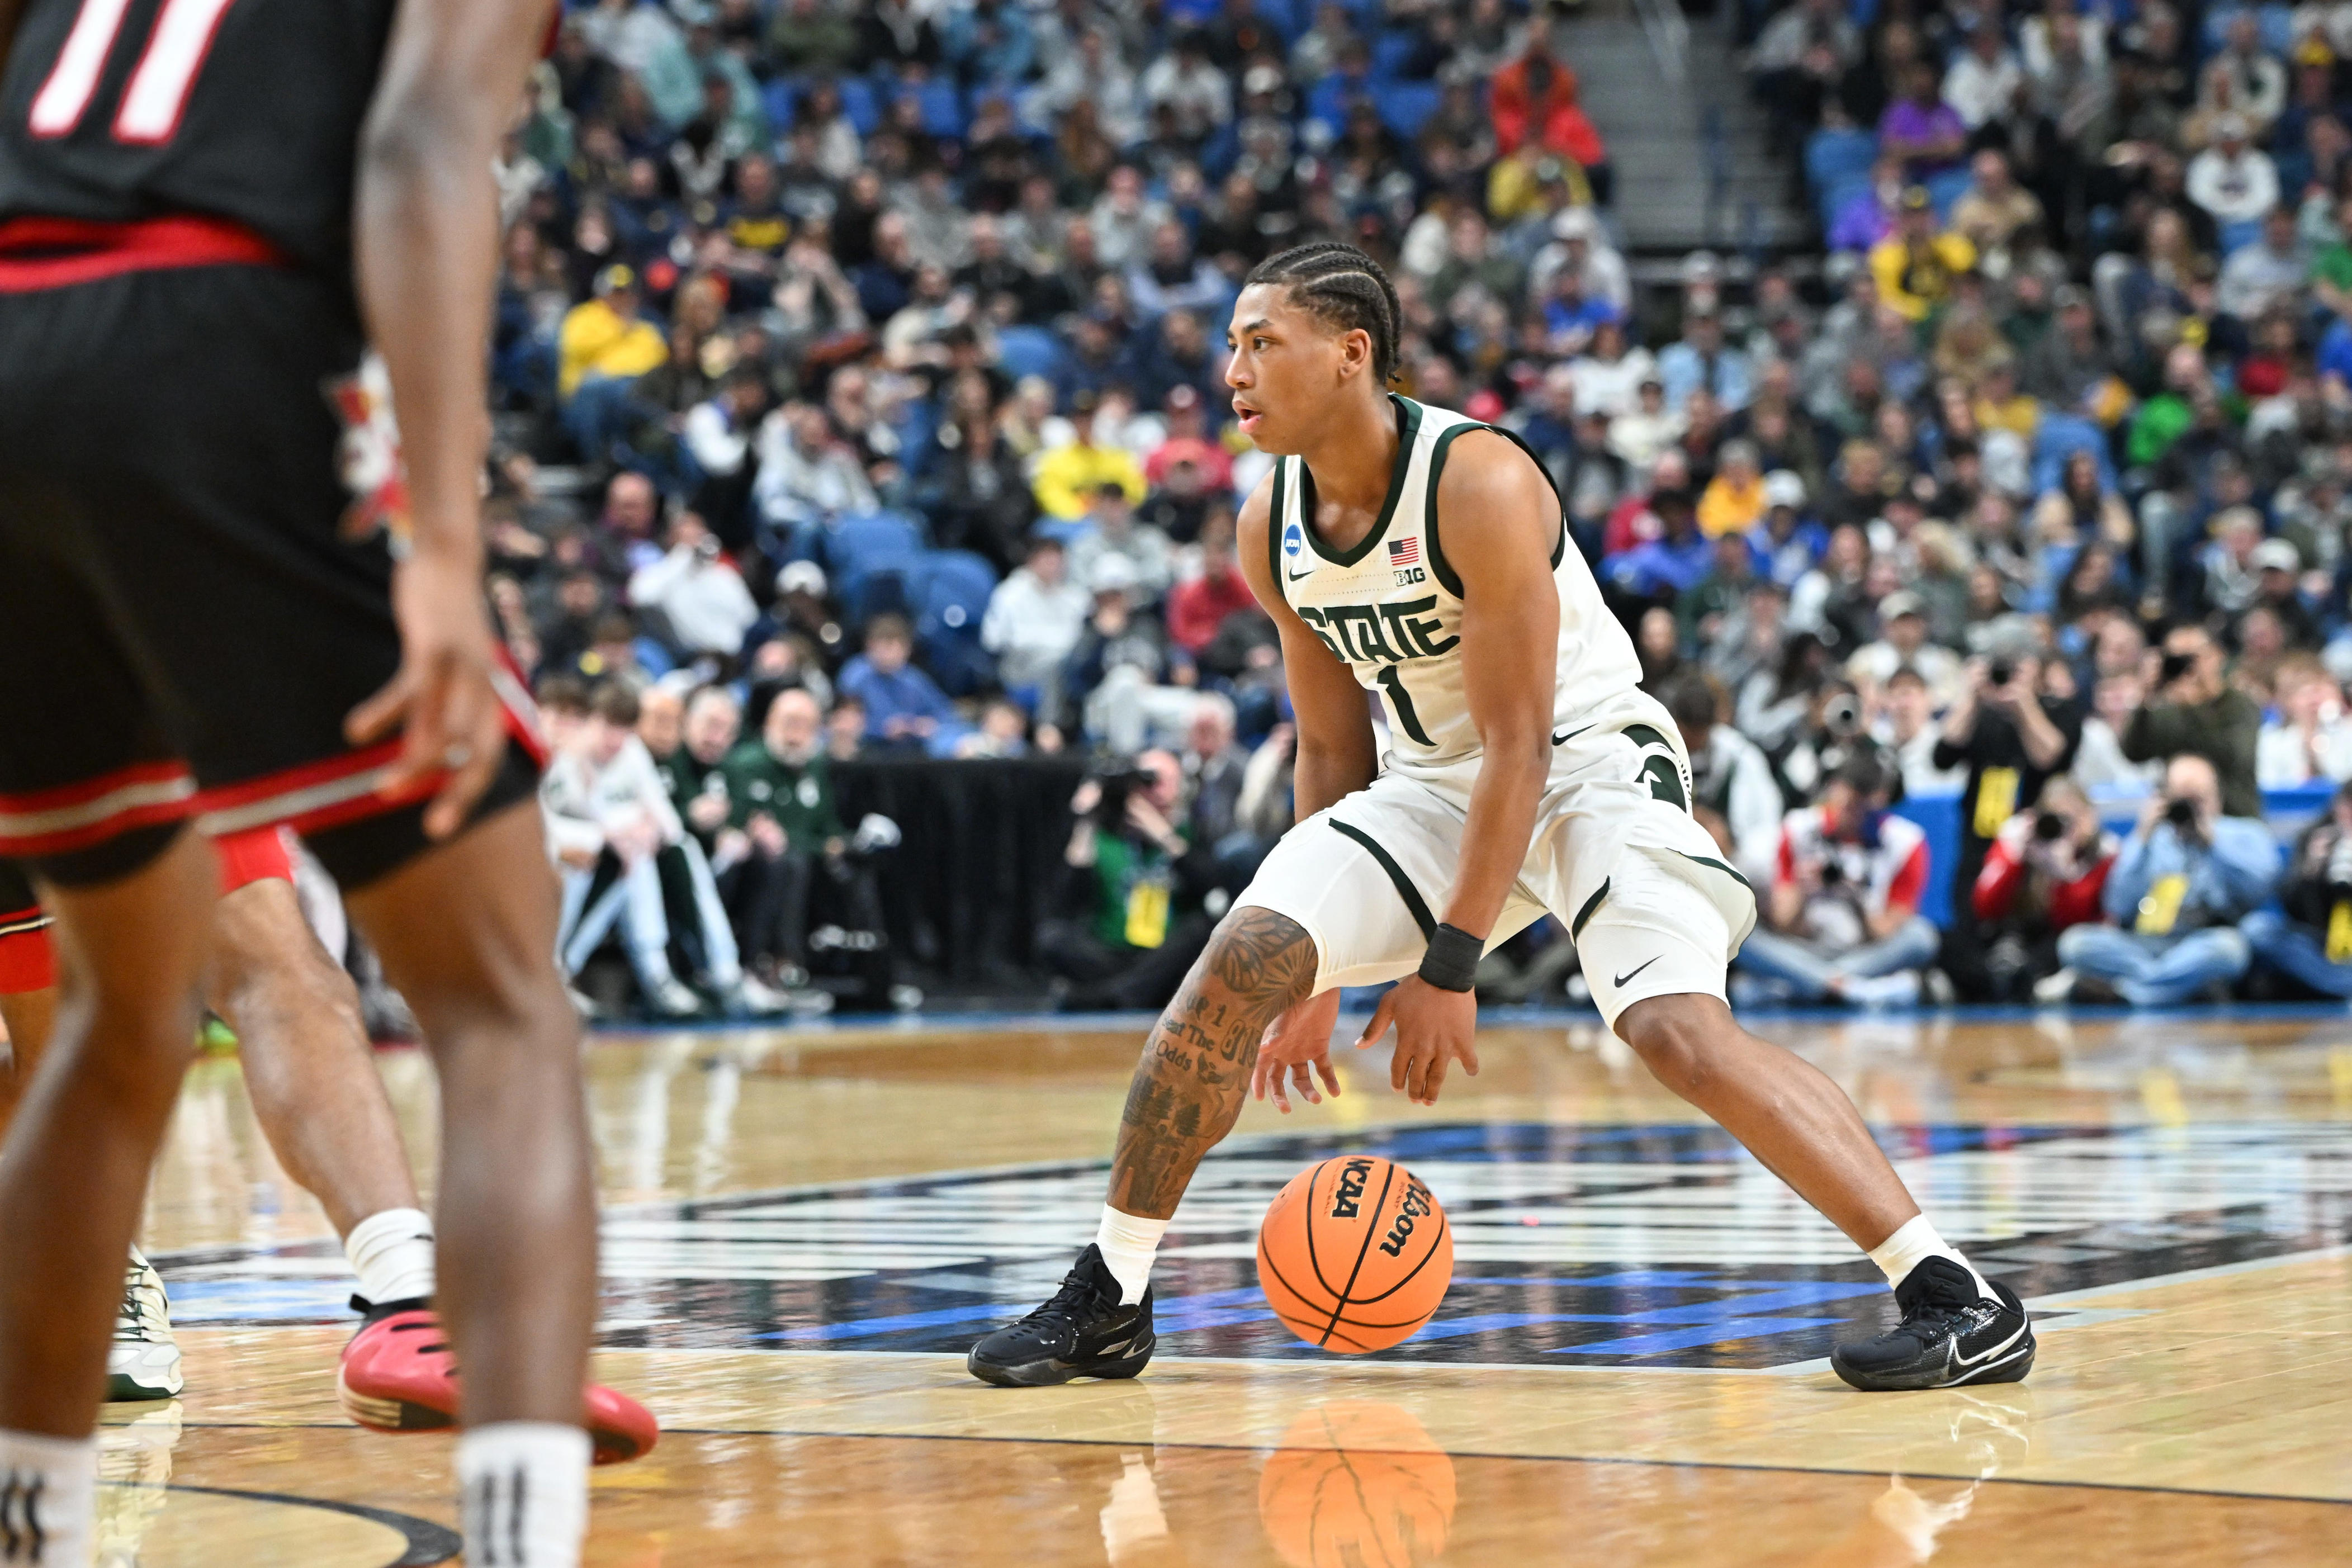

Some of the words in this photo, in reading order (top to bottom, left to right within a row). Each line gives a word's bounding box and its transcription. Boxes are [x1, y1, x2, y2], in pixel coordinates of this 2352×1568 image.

[1298, 594, 1460, 664] STATE
[1377, 665, 1437, 746] 1
[1156, 1040, 1192, 1071] Odds
[1332, 1158, 1375, 1218] NCAA
